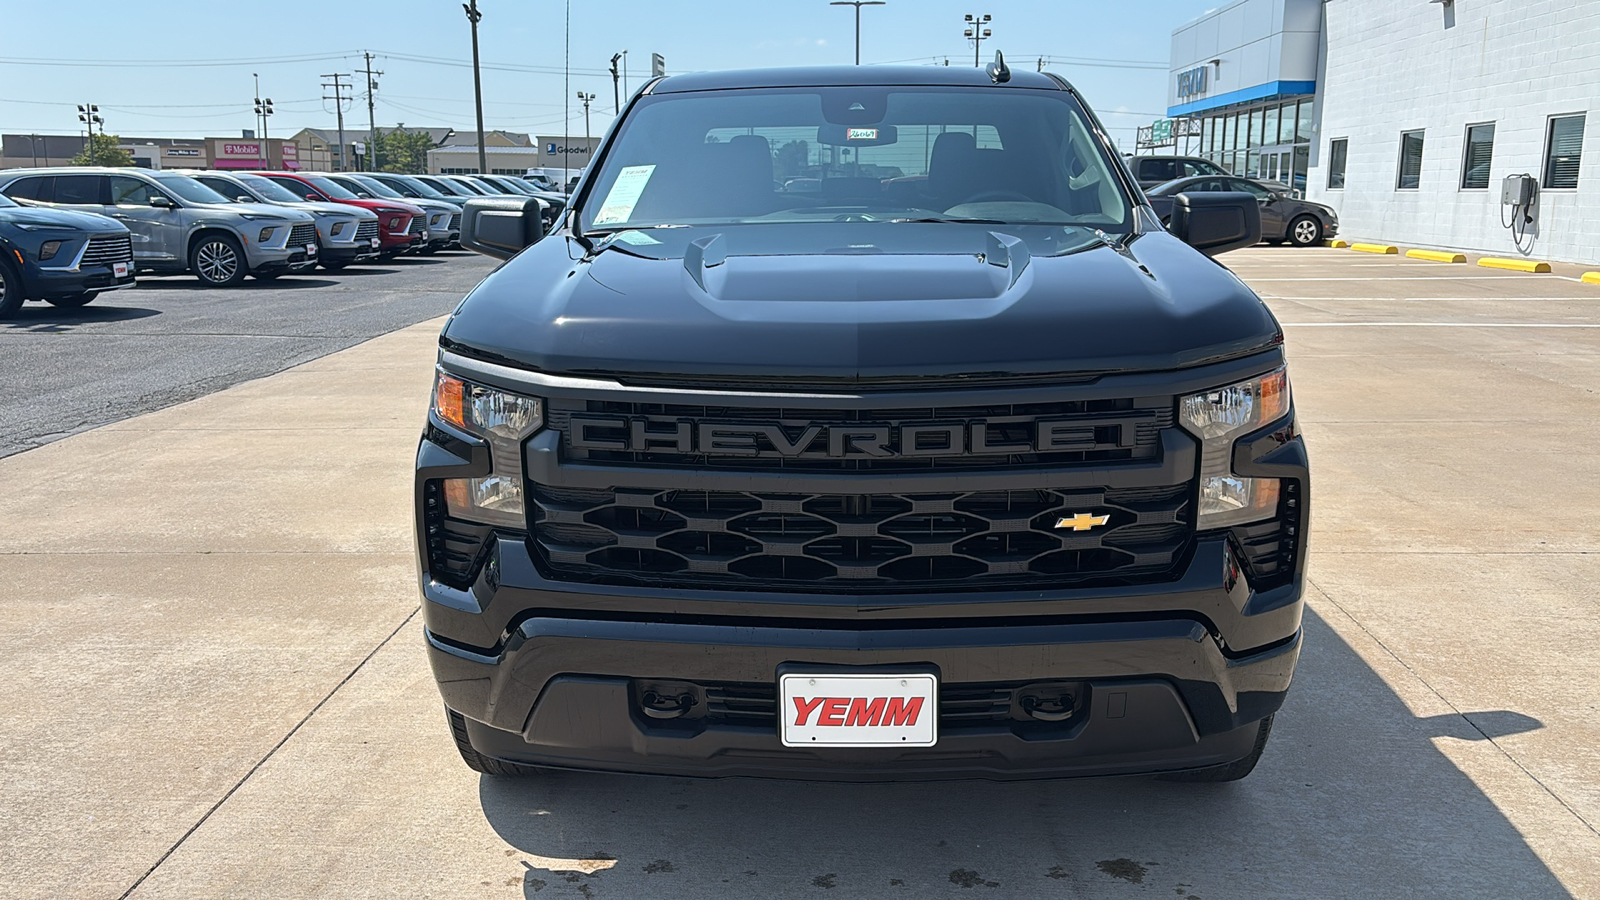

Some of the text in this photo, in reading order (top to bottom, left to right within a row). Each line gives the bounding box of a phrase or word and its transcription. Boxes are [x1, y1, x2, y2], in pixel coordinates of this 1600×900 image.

[557, 146, 591, 154] Goodwil
[570, 412, 1156, 458] CHEVROLET
[792, 697, 925, 726] YEMM
